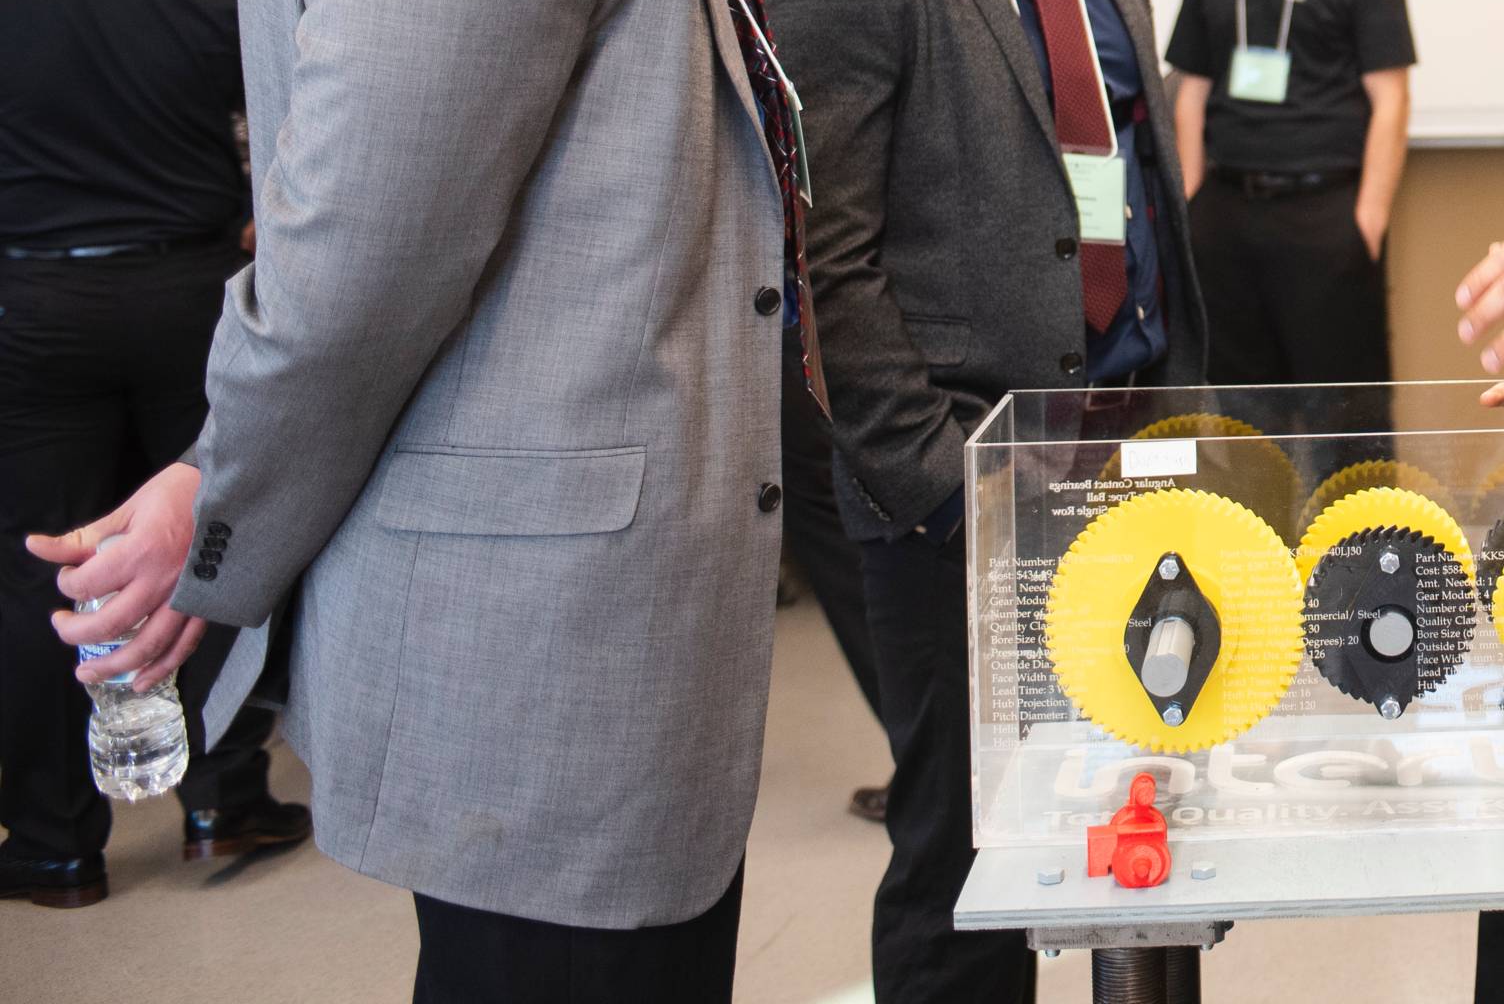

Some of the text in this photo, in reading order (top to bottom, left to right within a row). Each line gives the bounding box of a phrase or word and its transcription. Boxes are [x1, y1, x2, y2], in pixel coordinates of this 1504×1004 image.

[989, 557, 1009, 567] Part
[1013, 556, 1056, 567] Number:
[1415, 552, 1436, 563] Part
[1415, 566, 1440, 576] Cost:
[1416, 579, 1440, 588] Amt.
[990, 584, 1014, 594] Amt.
[1416, 590, 1491, 602] Gear 4
[990, 597, 1013, 606] Gear
[1308, 598, 1320, 608] 40
[1416, 603, 1469, 614] Number of
[990, 609, 1031, 619] Number
[1357, 609, 1381, 619] Steel
[990, 617, 1152, 633] Quality Steel
[1416, 615, 1453, 628] Quality
[1455, 614, 1483, 625] Class:
[1308, 623, 1320, 634] 30
[1417, 629, 1439, 639] Bore
[1441, 628, 1461, 639] Size
[991, 634, 1036, 644] Bore Size
[1347, 635, 1359, 645] 20
[1416, 642, 1456, 652] Outside
[1308, 649, 1326, 659] 126
[1416, 654, 1439, 664] Face
[991, 659, 1053, 670] Outside Dia.
[992, 671, 1047, 683] Face Width
[1417, 667, 1441, 677] Lead
[1288, 675, 1318, 686] Weeks
[992, 684, 1055, 696] Lead Time: 3
[1299, 688, 1311, 698] 16
[992, 698, 1069, 710] Hub Projection:
[1299, 700, 1316, 710] 120
[992, 710, 1068, 722] Pitch Diameter:
[1171, 798, 1349, 827] Quality.
